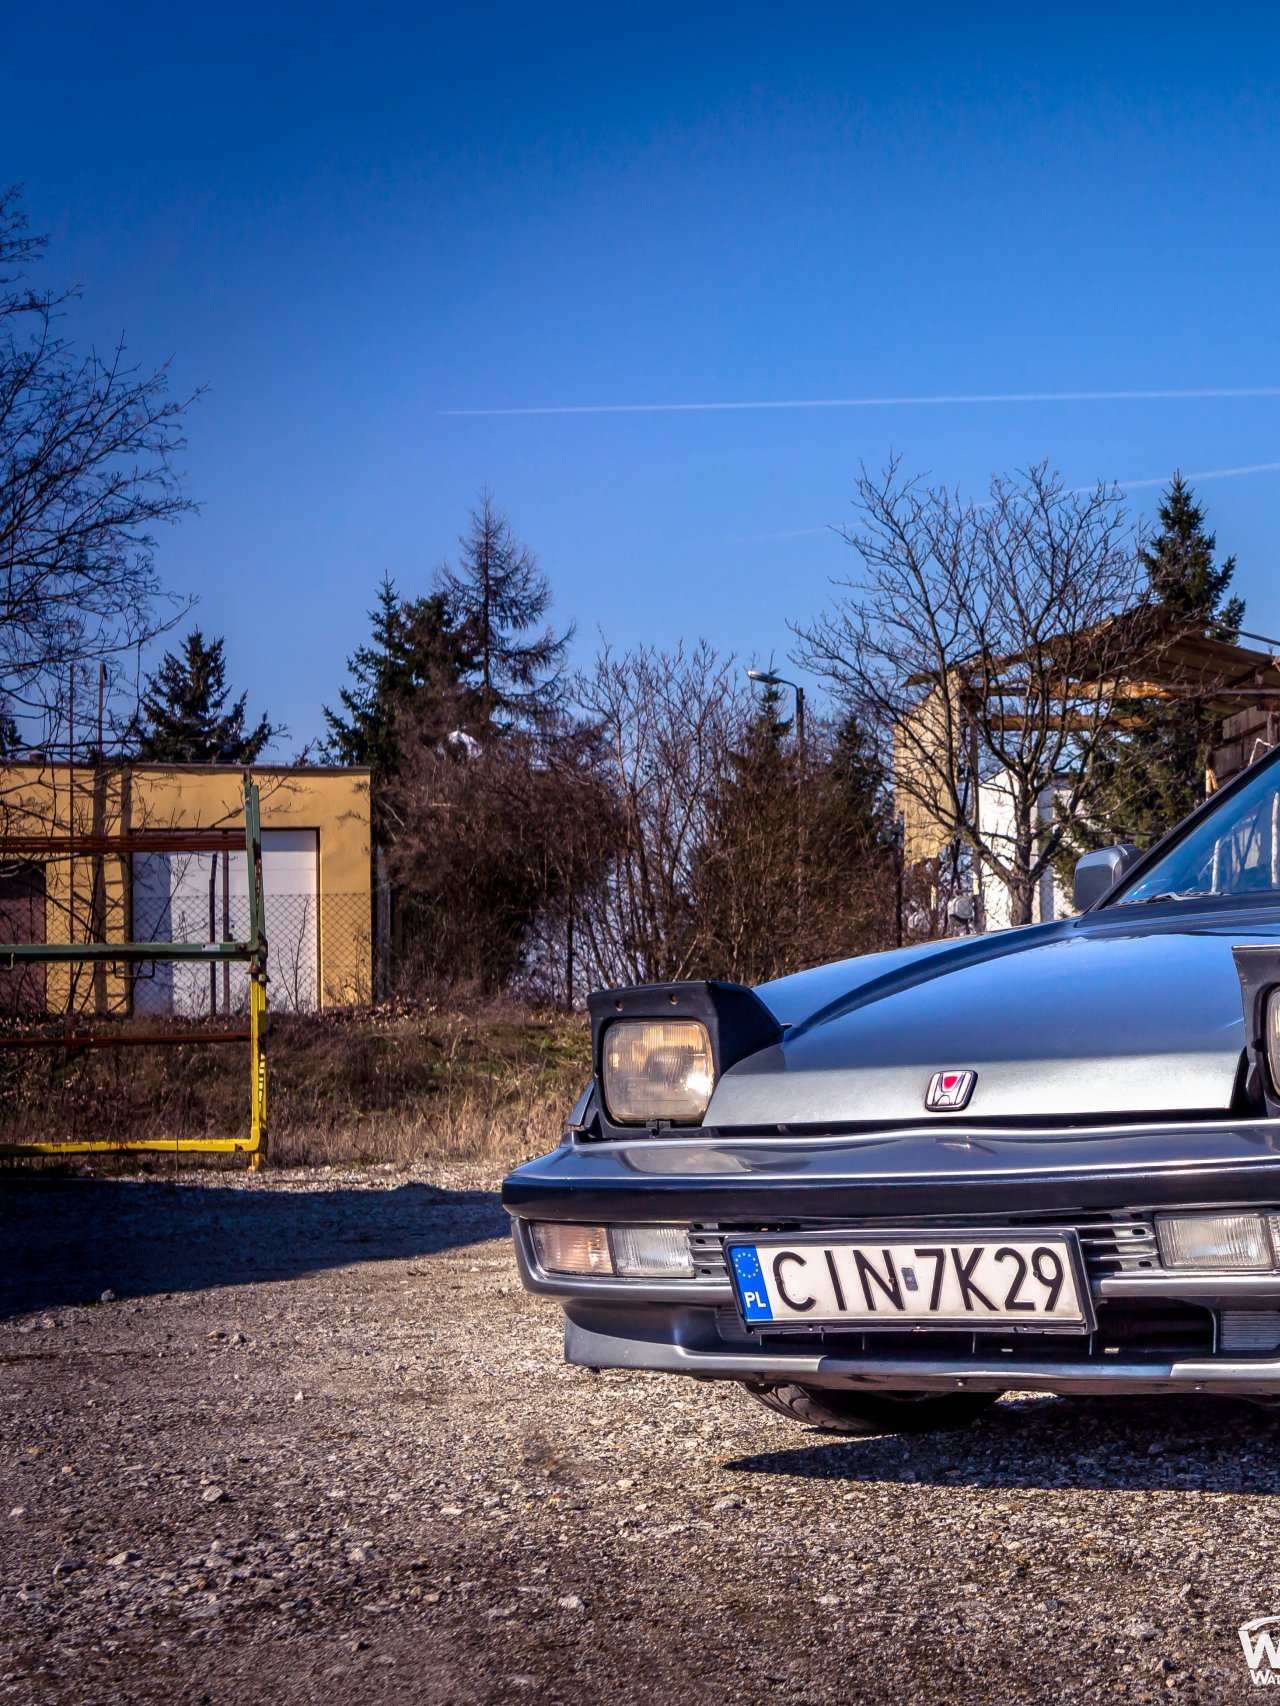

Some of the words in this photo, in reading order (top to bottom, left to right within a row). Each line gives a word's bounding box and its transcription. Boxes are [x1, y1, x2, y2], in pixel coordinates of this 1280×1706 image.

[744, 1291, 767, 1308] PL
[772, 1249, 906, 1312] CIN
[914, 1246, 1065, 1312] 7K29
